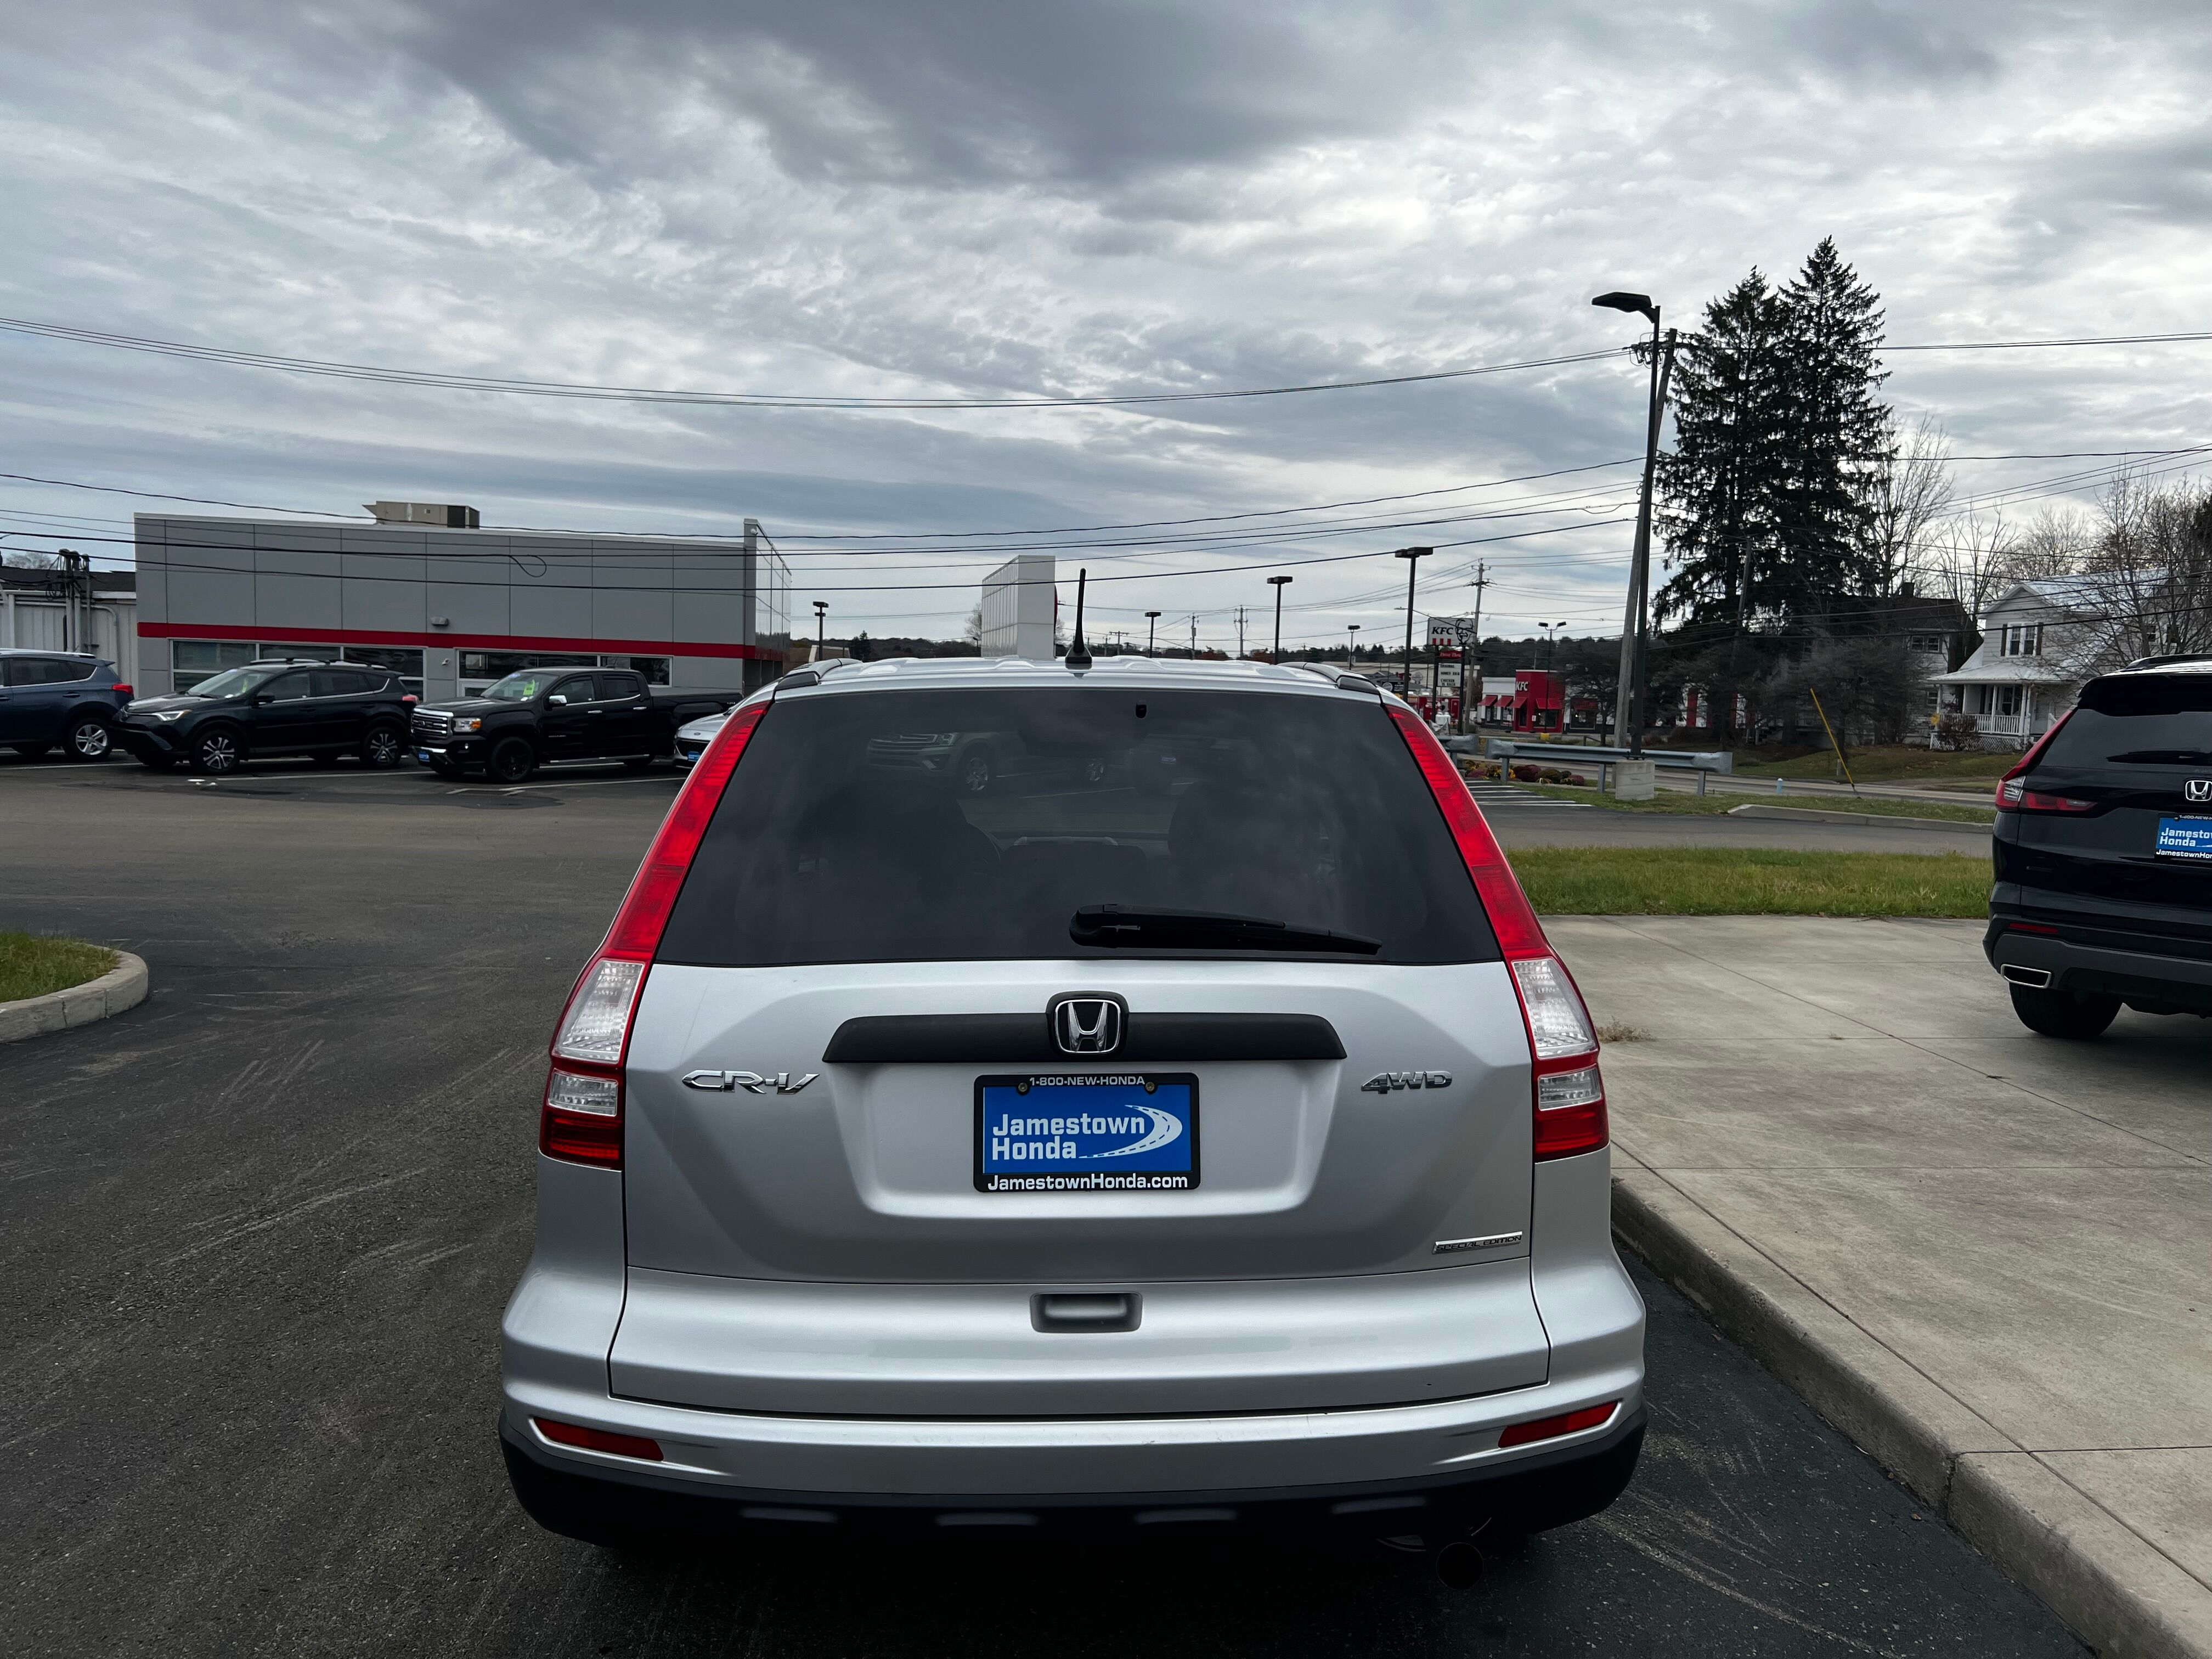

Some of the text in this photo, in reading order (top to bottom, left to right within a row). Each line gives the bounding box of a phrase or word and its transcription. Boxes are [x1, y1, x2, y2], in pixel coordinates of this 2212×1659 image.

[1431, 627, 1453, 635] KFC
[1515, 681, 1528, 691] KFC
[2161, 827, 2212, 839] Jamesto
[2159, 836, 2196, 847] Honda
[682, 1069, 820, 1095] CR-V
[1029, 1076, 1146, 1086] 1-800-NEW-HONDA
[1361, 1070, 1453, 1094] 4WD
[992, 1113, 1145, 1136] Jamestown
[992, 1136, 1077, 1160] Honda
[988, 1173, 1188, 1190] JamestownHonda.com
[1436, 1235, 1522, 1251] SPECIAL EDITION
